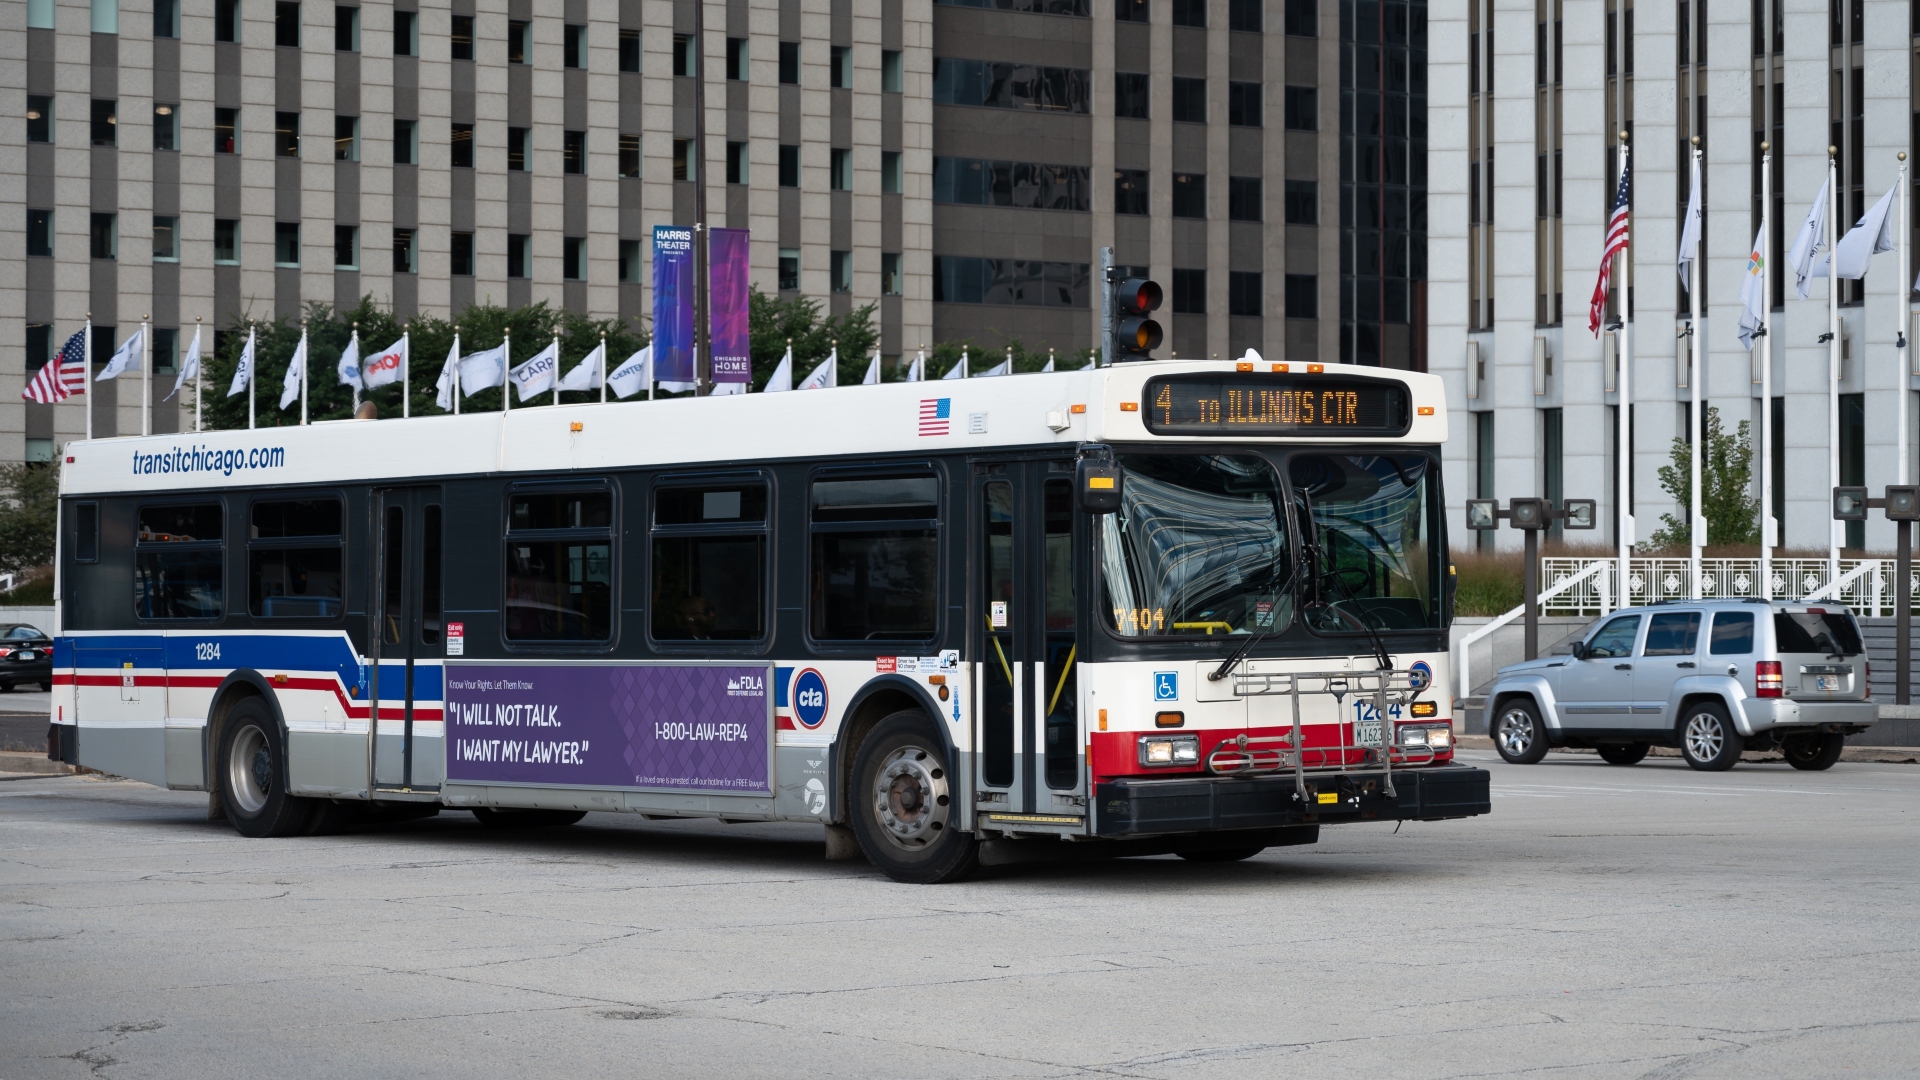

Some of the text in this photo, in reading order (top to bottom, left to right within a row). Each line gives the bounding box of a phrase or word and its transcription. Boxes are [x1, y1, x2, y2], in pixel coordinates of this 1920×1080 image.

[656, 230, 691, 240] HARRIS
[656, 241, 690, 250] THEATER
[715, 362, 748, 373] HOME
[1156, 384, 1357, 425] 4 TO ILLINOIS CTR
[133, 444, 284, 476] transitchicago.com
[1114, 608, 1164, 630] 7404
[196, 643, 220, 660] 1284
[449, 680, 463, 689] Know
[464, 680, 476, 689] Your
[503, 680, 517, 690] Them
[740, 676, 763, 689] FDLA
[799, 688, 822, 707] cta
[463, 703, 493, 726] WILL
[496, 704, 523, 726] NOT
[524, 704, 561, 727] TALK.
[655, 722, 748, 741] 1-800-LAW-REP4
[1364, 728, 1392, 742] 16236
[457, 739, 589, 765] I WANT MY LAWYER."
[644, 776, 656, 784] loved
